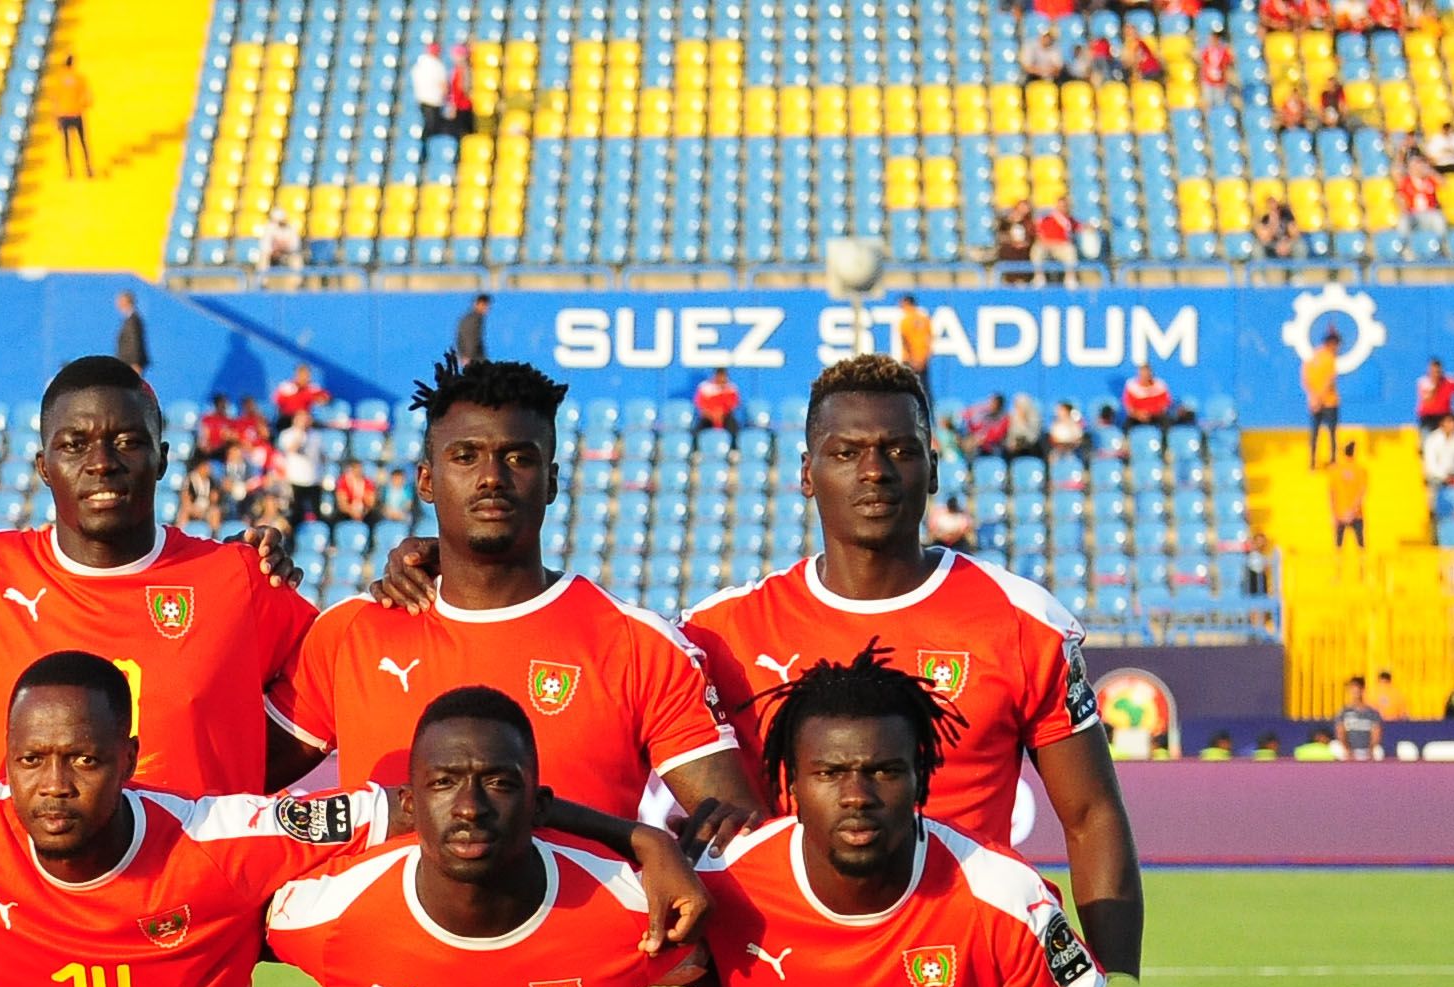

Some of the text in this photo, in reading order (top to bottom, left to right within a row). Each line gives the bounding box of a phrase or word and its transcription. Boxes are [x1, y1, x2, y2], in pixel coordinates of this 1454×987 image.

[554, 305, 1198, 368] SUEZ STADIUM
[335, 798, 347, 833] CAF
